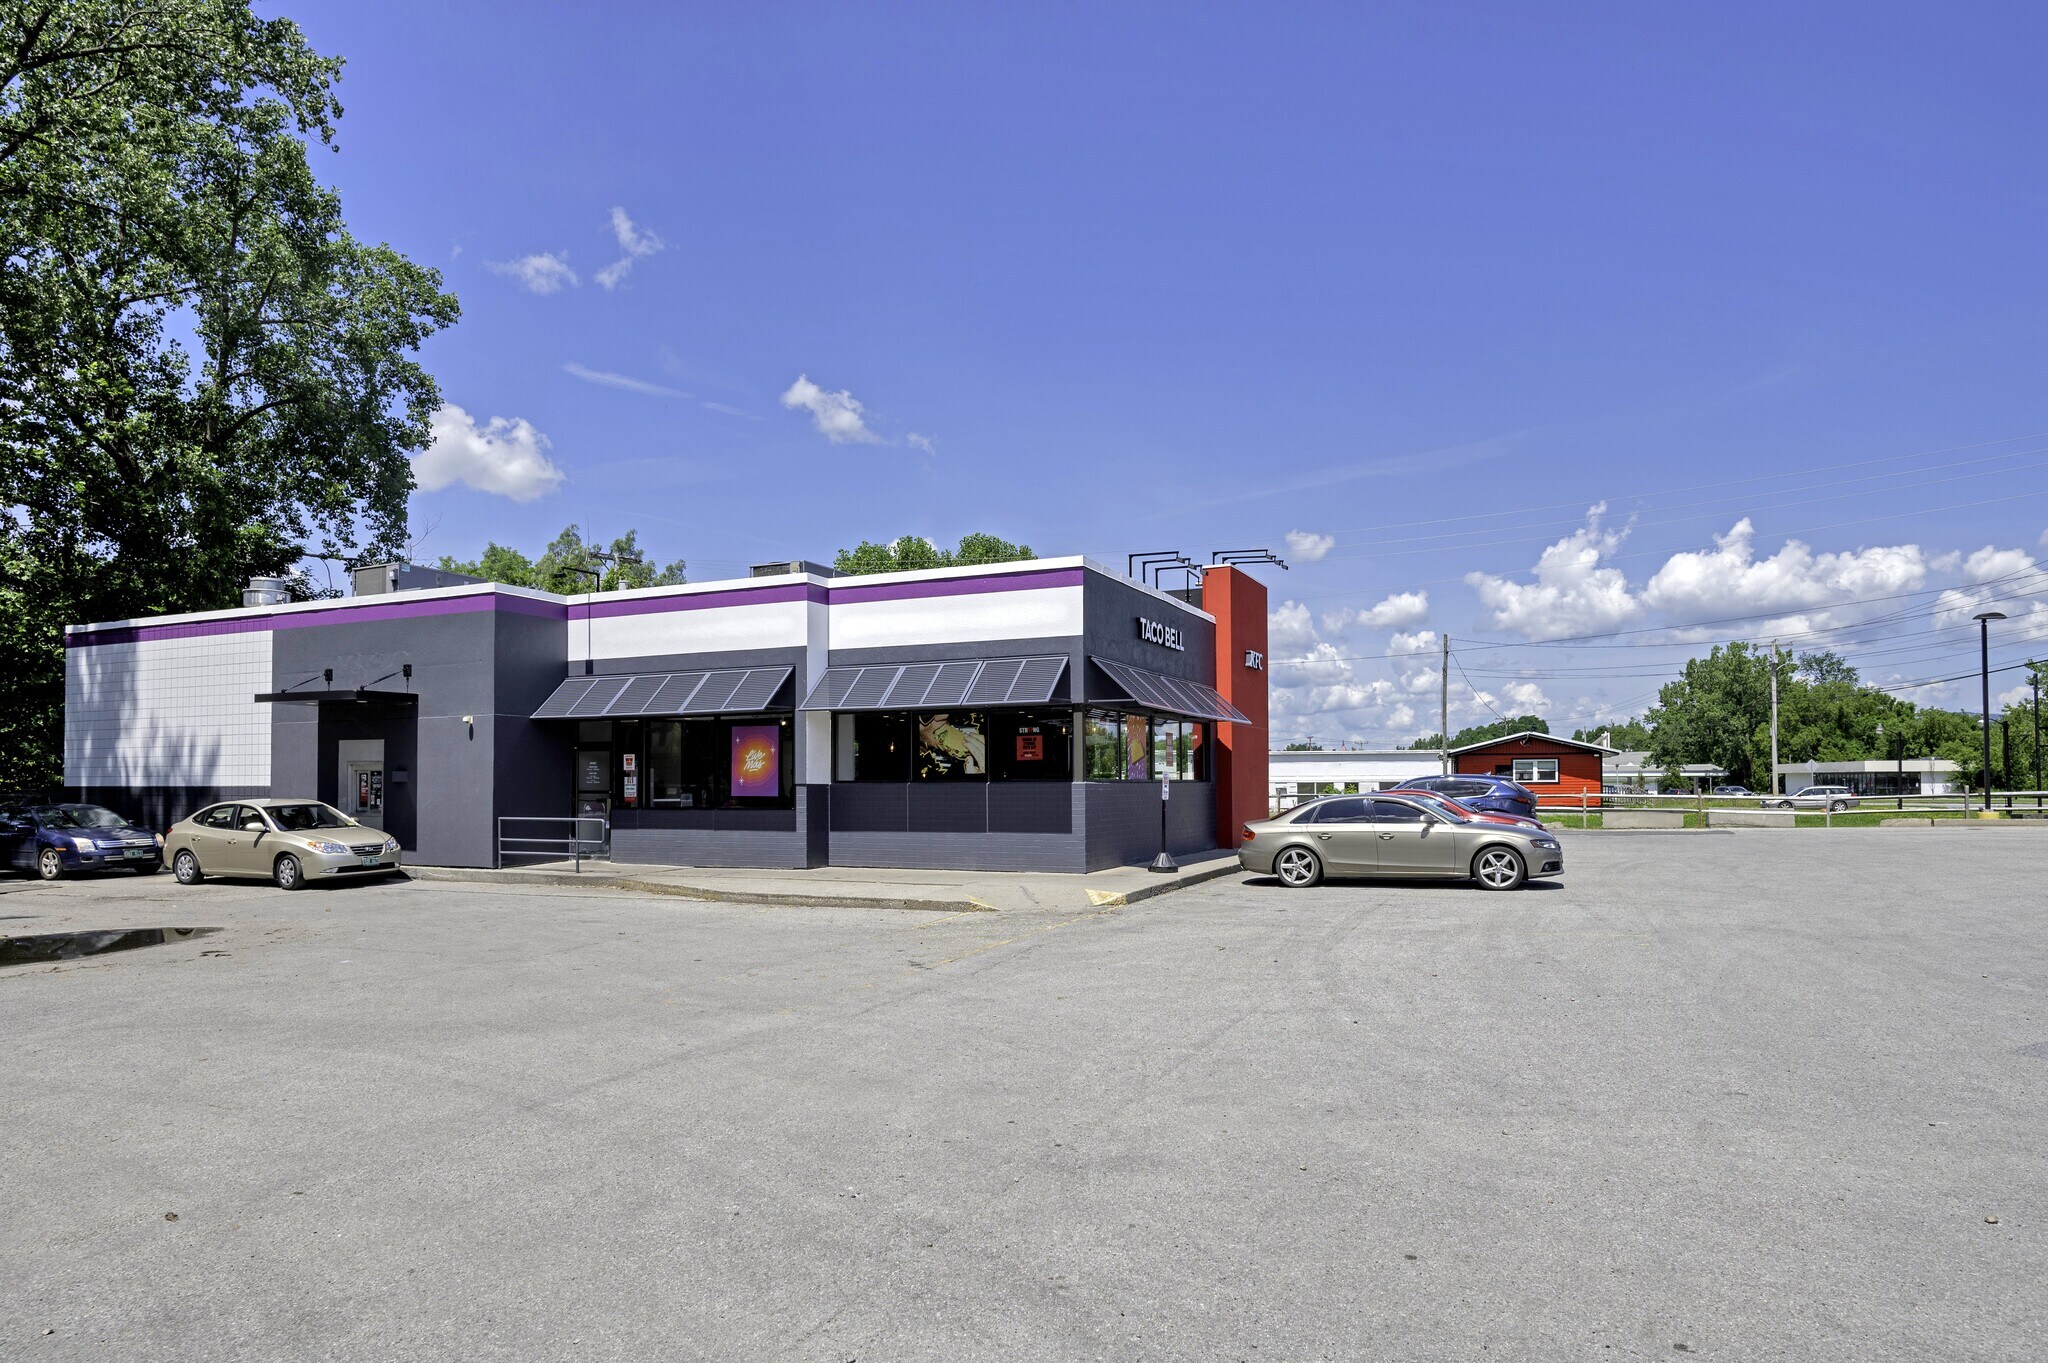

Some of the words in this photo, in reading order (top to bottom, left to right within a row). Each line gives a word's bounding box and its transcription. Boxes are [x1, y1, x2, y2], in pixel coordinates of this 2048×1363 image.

[1140, 617, 1164, 645] TACO
[1165, 626, 1184, 651] BELL
[1249, 650, 1263, 670] KFC
